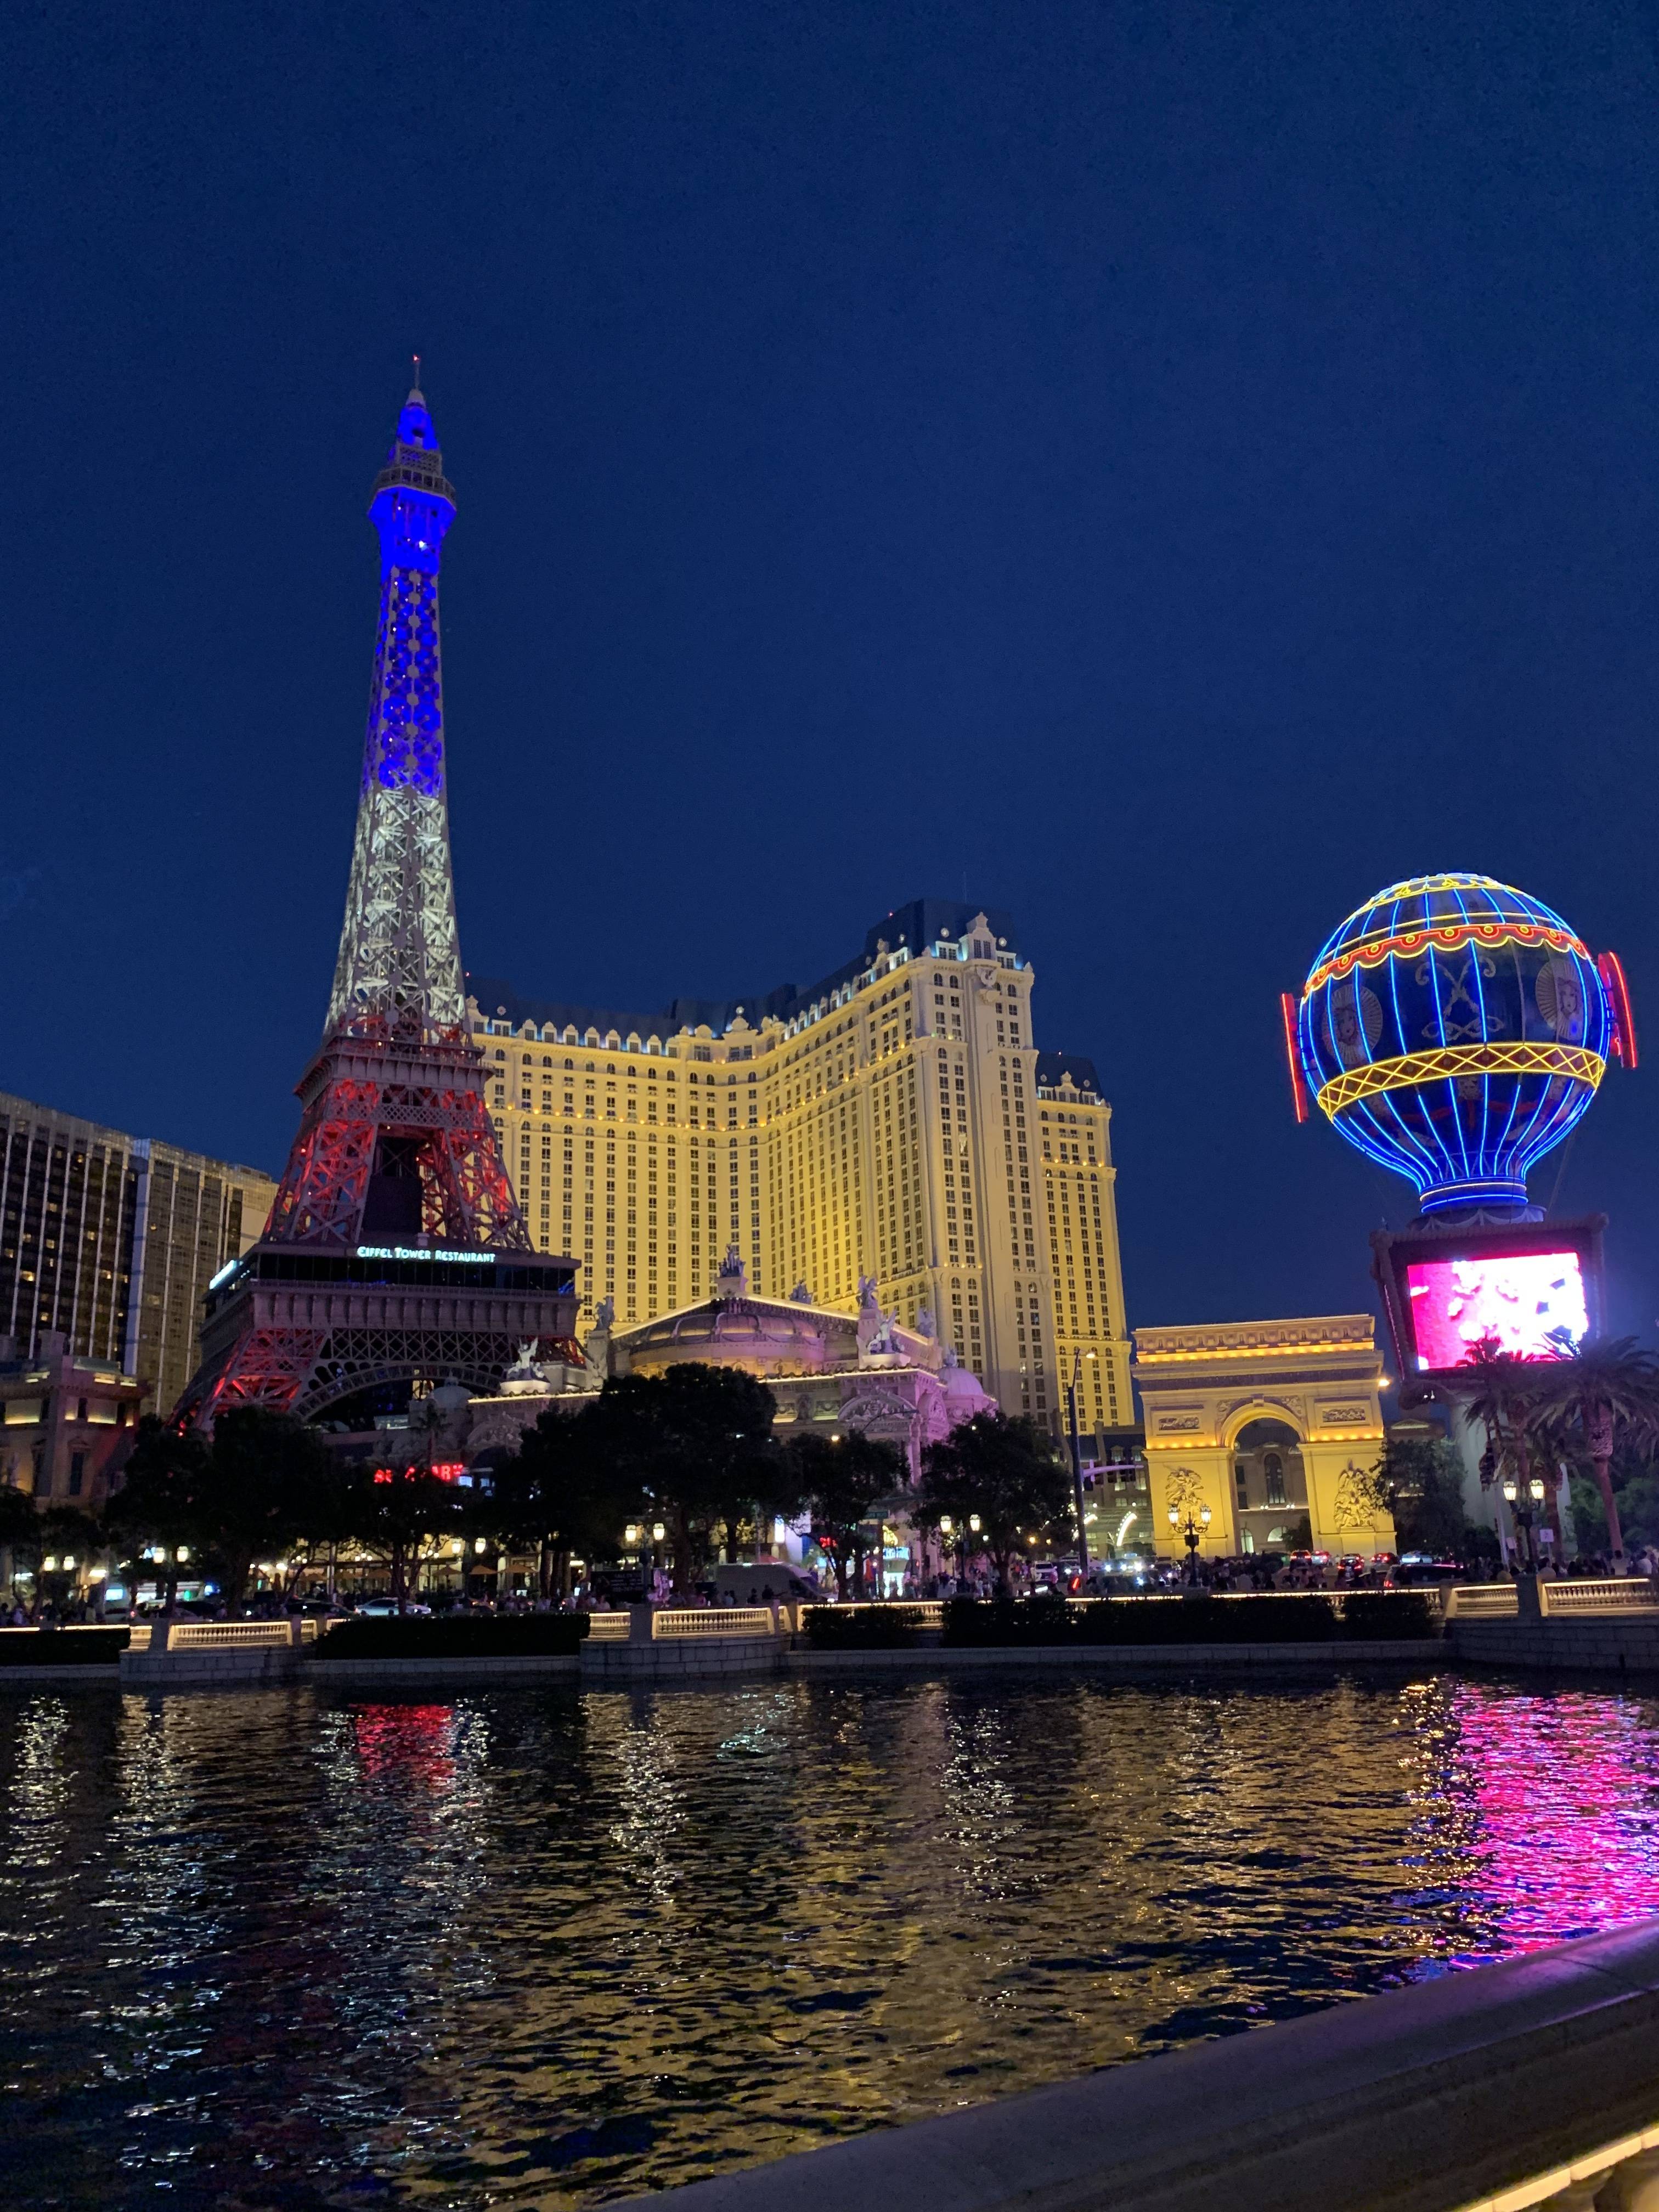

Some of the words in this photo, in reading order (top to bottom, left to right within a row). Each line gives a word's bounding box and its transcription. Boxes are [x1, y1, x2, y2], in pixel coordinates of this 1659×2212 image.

[357, 1246, 392, 1258] EIFFEL
[394, 1248, 431, 1259] TOWER
[435, 1250, 495, 1262] RESTAURANT
